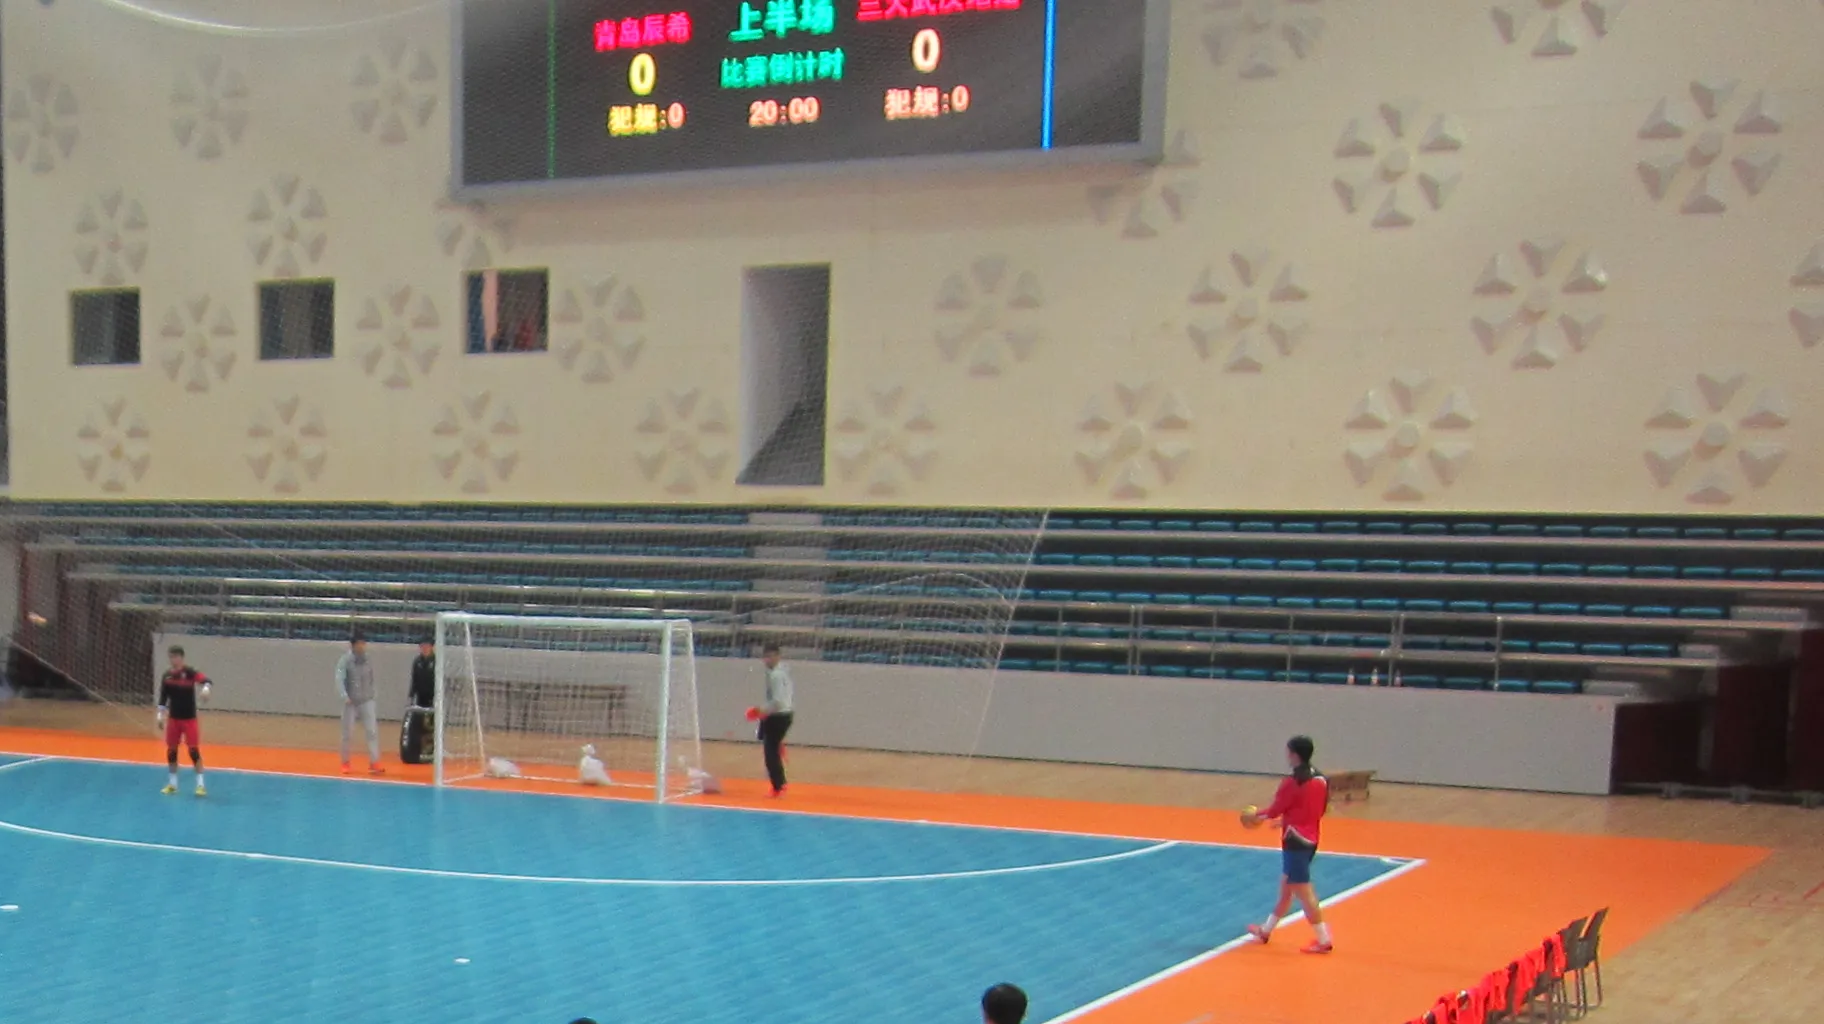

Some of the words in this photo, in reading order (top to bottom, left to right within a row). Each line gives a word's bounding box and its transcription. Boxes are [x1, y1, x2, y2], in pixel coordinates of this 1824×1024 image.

[594, 12, 693, 51] 青岛辰希
[728, 0, 835, 41] 上半场
[720, 47, 844, 88] 比赛倒计时
[912, 28, 940, 72] 0
[629, 52, 656, 95] 0
[748, 97, 821, 127] 20:00
